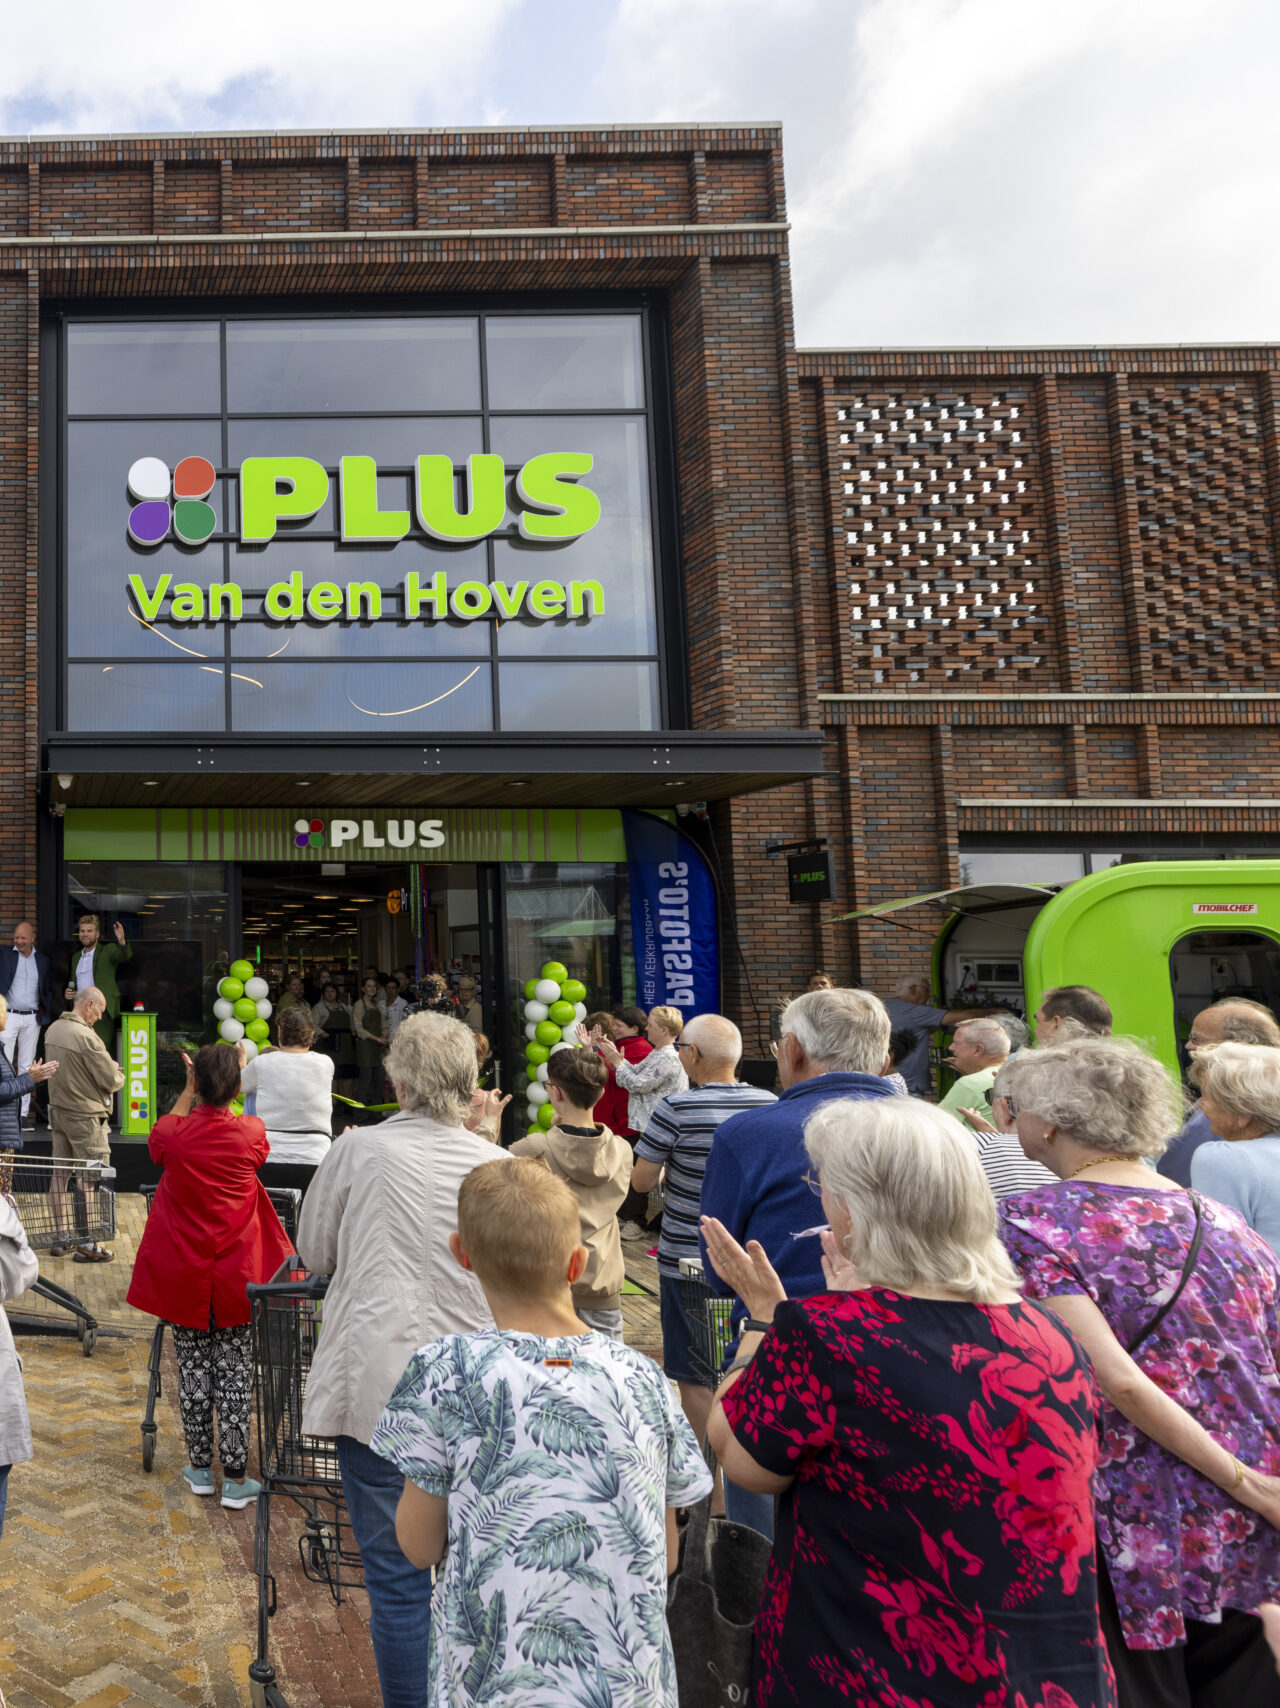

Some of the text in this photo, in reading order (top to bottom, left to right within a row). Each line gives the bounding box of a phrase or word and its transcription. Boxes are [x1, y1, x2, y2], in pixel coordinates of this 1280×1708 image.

[240, 452, 601, 543] PLUS
[128, 571, 605, 621] Van den Hoven
[330, 819, 445, 848] PLUS
[800, 871, 826, 883] PLUS
[1198, 904, 1255, 912] MOBILCHEF
[130, 1029, 149, 1098] PLUS
